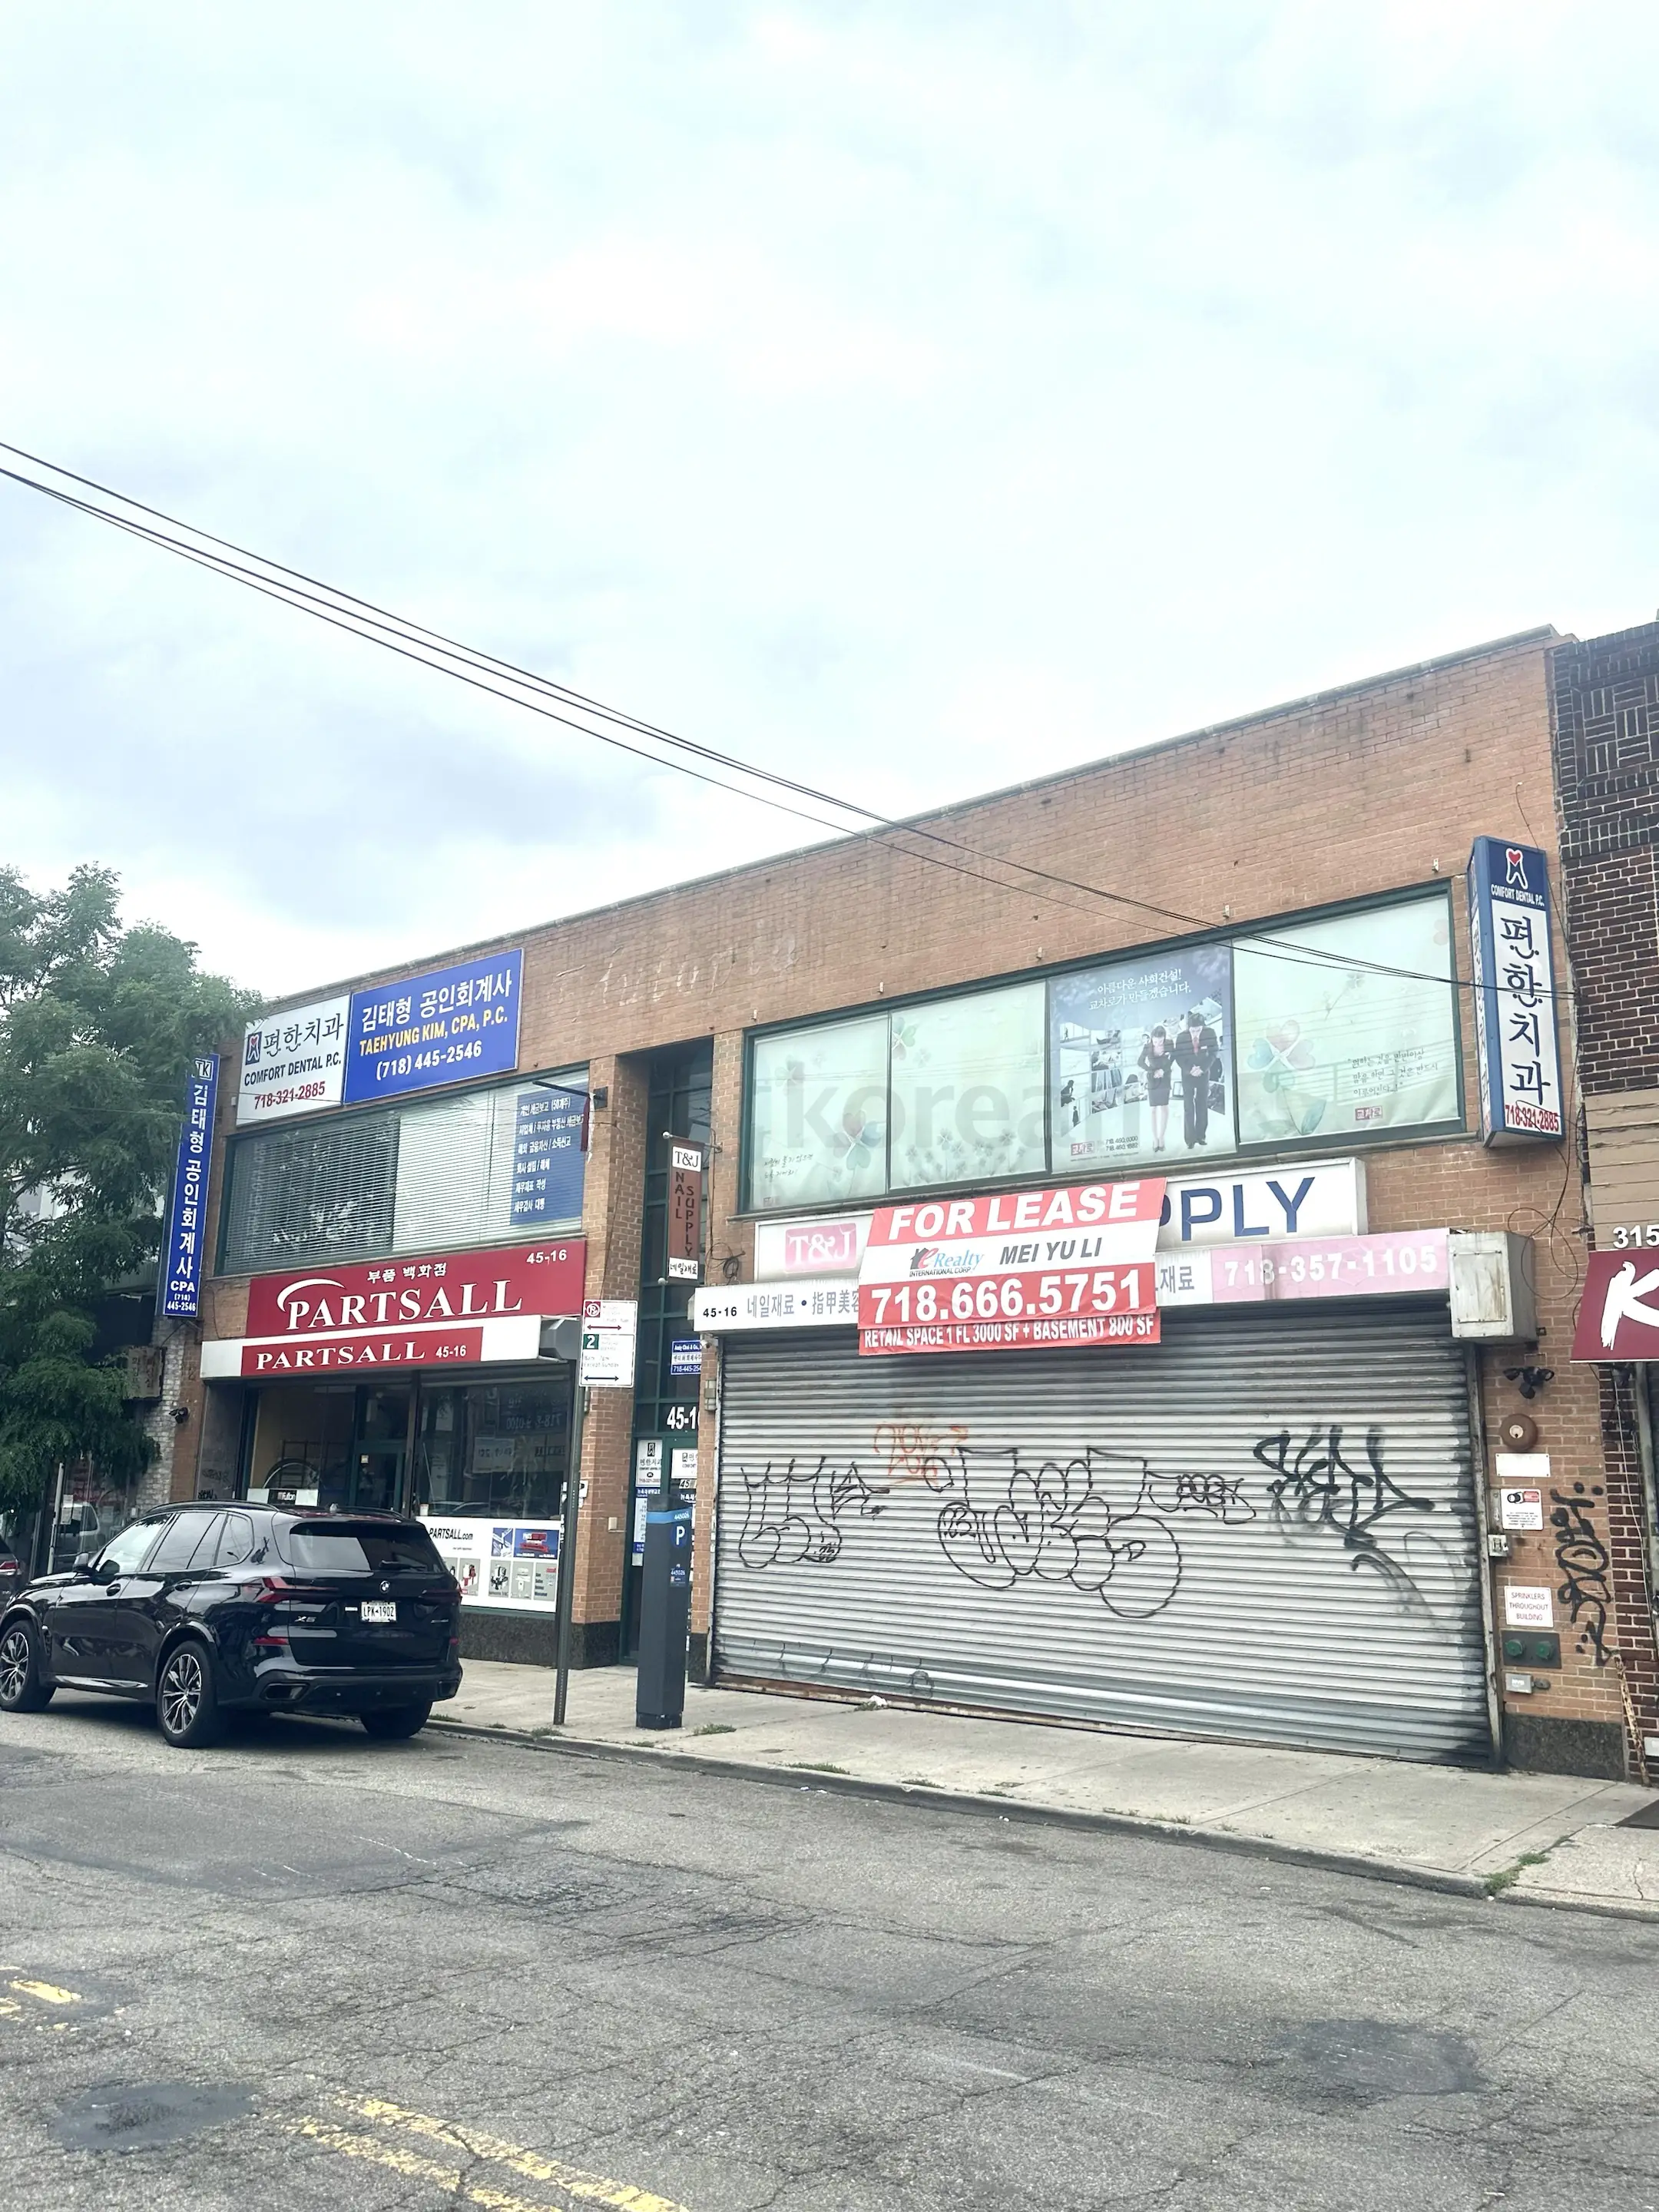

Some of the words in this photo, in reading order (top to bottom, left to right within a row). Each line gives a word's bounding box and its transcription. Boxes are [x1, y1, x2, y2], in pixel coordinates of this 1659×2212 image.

[1491, 883, 1515, 899] COMFORT
[1515, 889, 1535, 905] DENTAL
[362, 996, 412, 1033] 김태형
[420, 969, 512, 1018] 공인회계사
[1098, 979, 1137, 995] 아름다운
[1500, 916, 1551, 1106] 편한치과
[263, 1013, 344, 1057] 편한치과
[359, 1028, 419, 1057] TAEHYUNG
[422, 1021, 448, 1041] KIM,
[452, 1012, 480, 1035] CPA,
[483, 1006, 508, 1027] P.C.
[244, 1064, 286, 1087] COMFORT
[288, 1056, 323, 1076] DENTAL
[326, 1051, 341, 1068] P.C.
[376, 1055, 412, 1081] (718)
[414, 1040, 482, 1070] 445-2546
[254, 1081, 326, 1110] 718-321-2885
[190, 1084, 208, 1154] 김태형
[1505, 1104, 1559, 1132] 718-321-2885
[675, 1151, 699, 1167] T&J
[176, 1159, 202, 1279] 공인회계사
[675, 1171, 684, 1219] NAIL
[685, 1185, 694, 1257] SUPPLY
[889, 1200, 976, 1241] FOR
[987, 1182, 1141, 1232] LEASE
[1158, 1176, 1316, 1242] PLY
[526, 1249, 568, 1265] 45-16
[788, 1227, 852, 1265] T&J
[999, 1243, 1039, 1265] MEI
[1046, 1240, 1075, 1261] YU
[1080, 1237, 1103, 1258] LI
[367, 1269, 396, 1283] 부품
[402, 1262, 448, 1280] 백화점
[909, 1268, 953, 1277] INTERNATIONAL
[1155, 1265, 1195, 1293] 재료
[1227, 1246, 1438, 1287] 718-357-1105
[171, 1280, 195, 1292] CPA
[871, 1269, 1141, 1324] 718.666.5751
[167, 1301, 196, 1312] 445-2546
[286, 1279, 523, 1330] PARTSALL
[747, 1293, 795, 1319] 네일재료
[586, 1335, 595, 1349] 2
[865, 1328, 903, 1349] RETAIL
[906, 1326, 945, 1346] SPACE
[946, 1326, 952, 1345] 1
[955, 1324, 970, 1344] FL
[972, 1323, 1002, 1343] 3000
[1004, 1322, 1019, 1341] SF
[1033, 1317, 1105, 1340] BASEMENT
[1108, 1316, 1134, 1336] 800
[1136, 1314, 1154, 1336] SF
[256, 1341, 426, 1370] PARTSALL
[435, 1345, 468, 1359] 45-16
[667, 1406, 700, 1429] 45-1
[677, 1525, 685, 1545] P
[1509, 1602, 1548, 1611] THROUGHOUT
